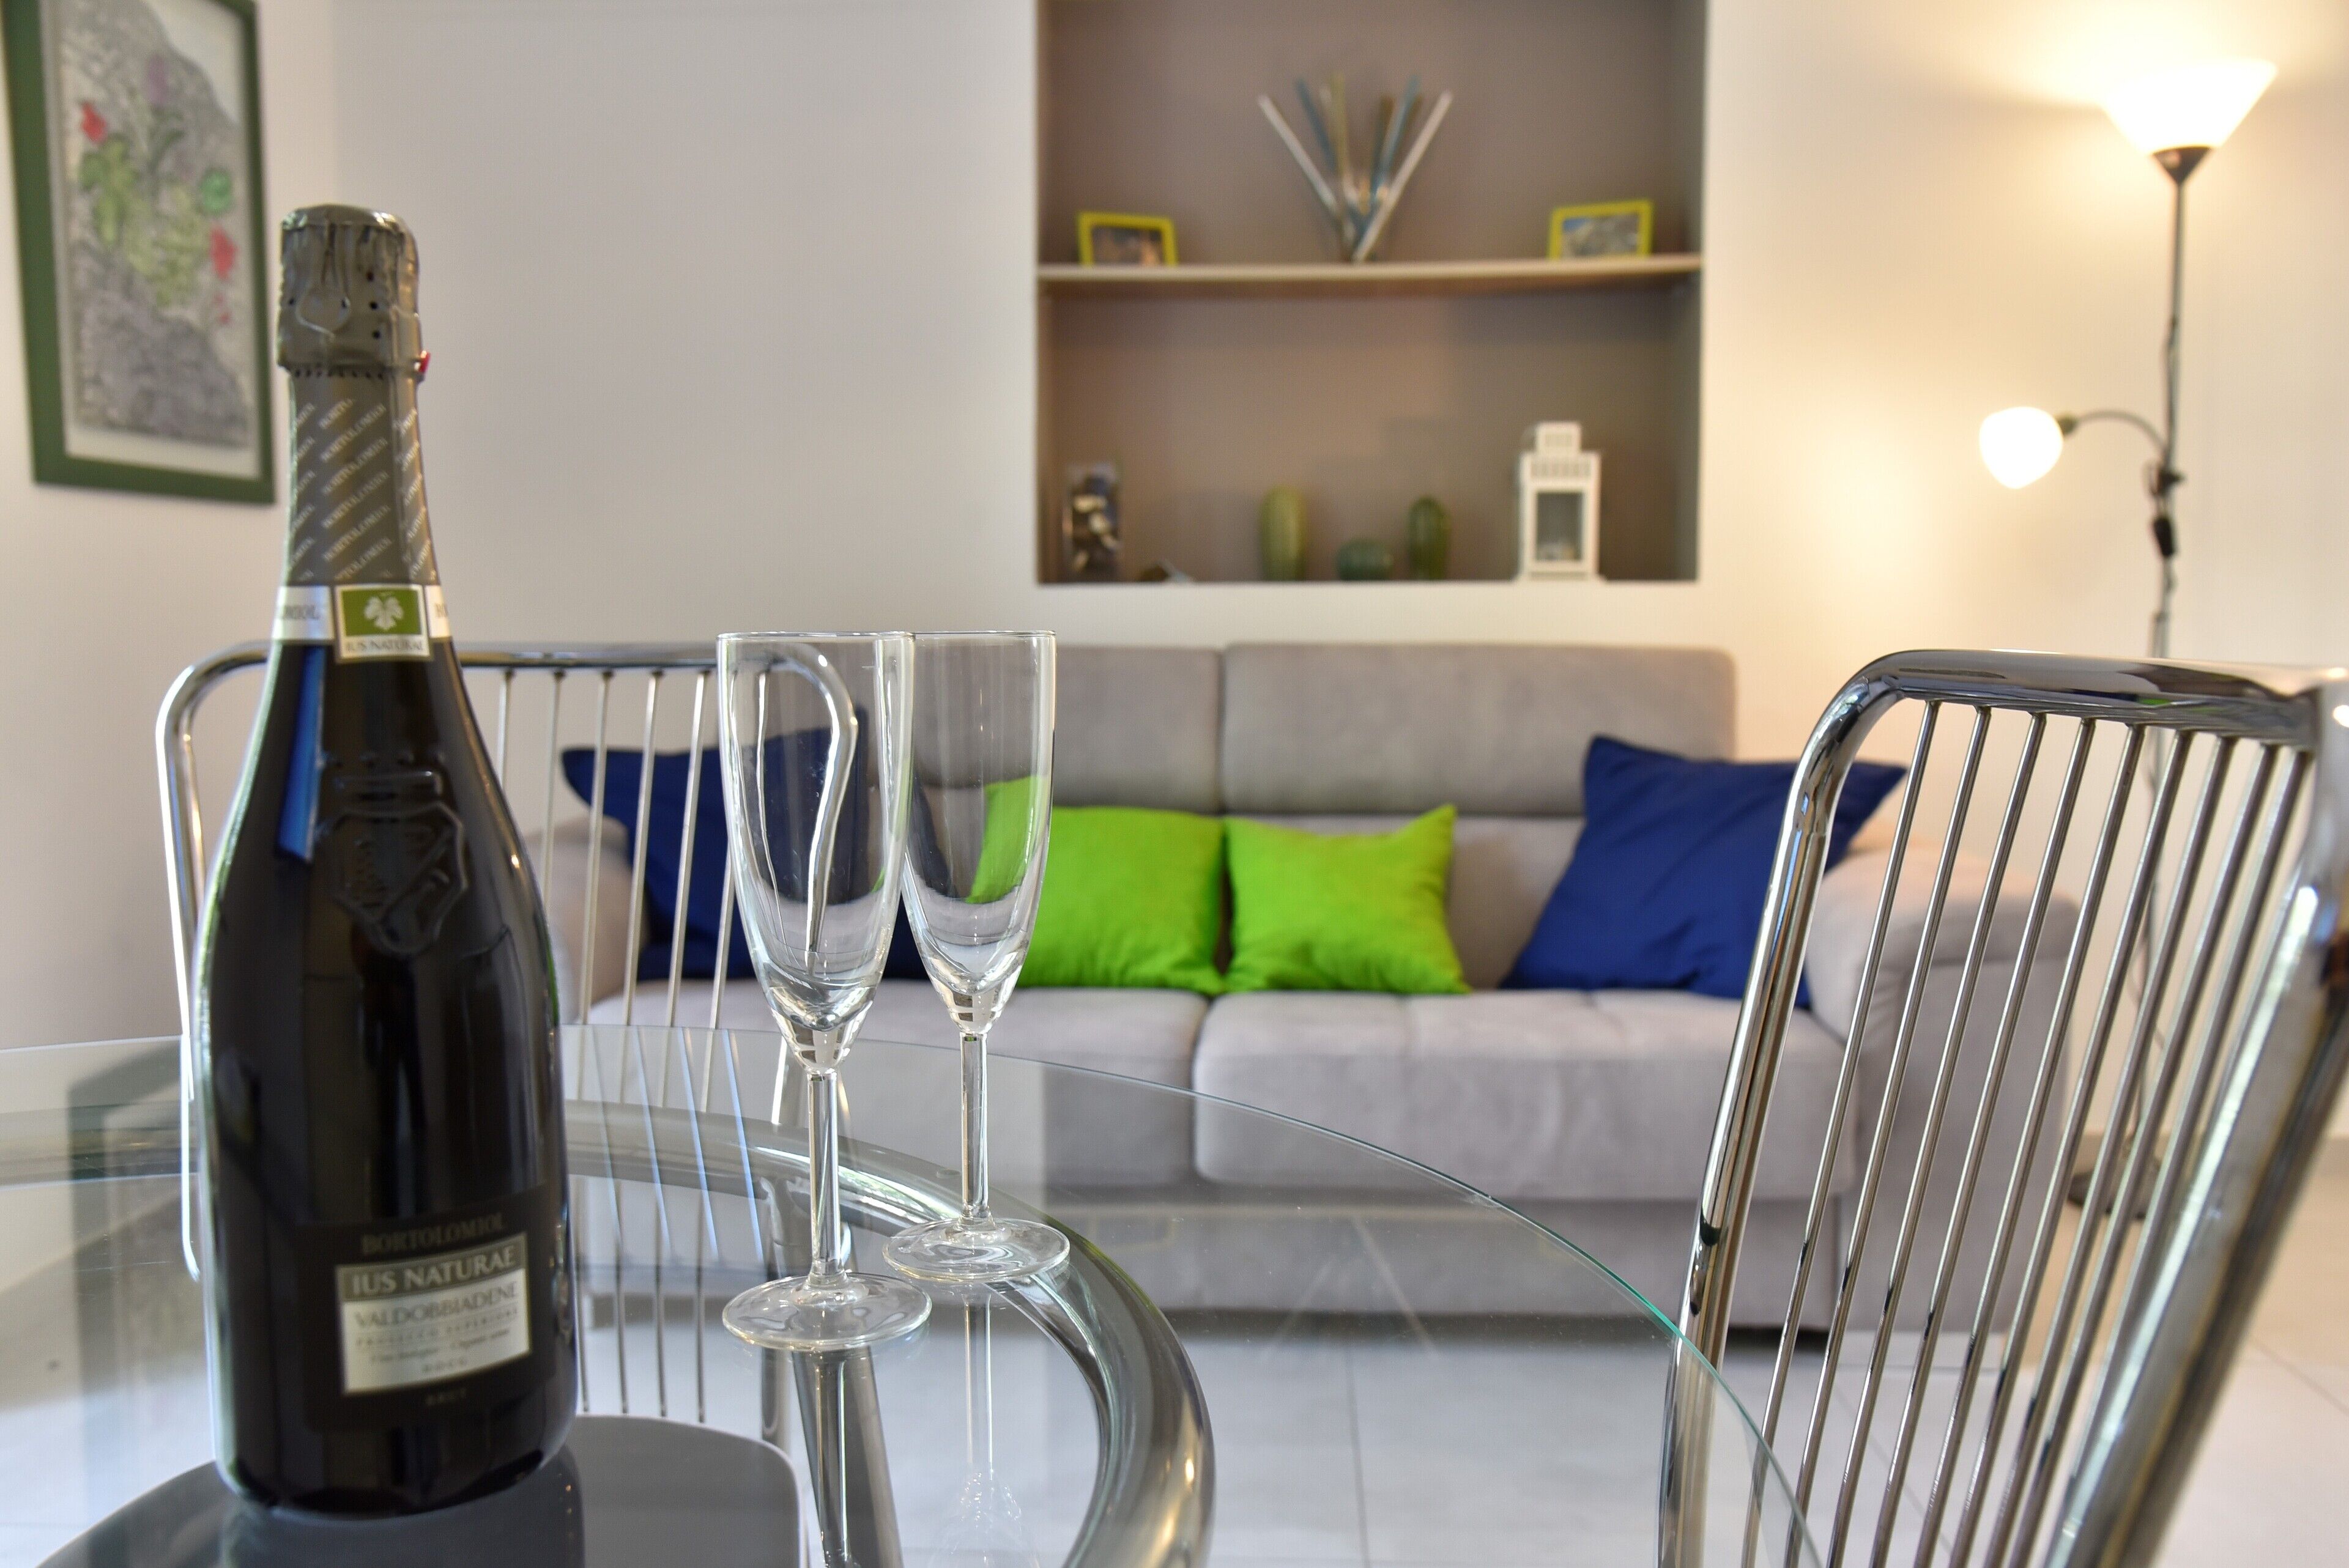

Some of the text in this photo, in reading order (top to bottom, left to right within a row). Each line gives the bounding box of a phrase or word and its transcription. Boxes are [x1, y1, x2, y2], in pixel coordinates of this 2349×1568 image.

[362, 1212, 503, 1256] BORTOLOMIOL
[351, 1245, 517, 1296] IUS NATURAE
[354, 1282, 519, 1329] VALDOBBIADENE
